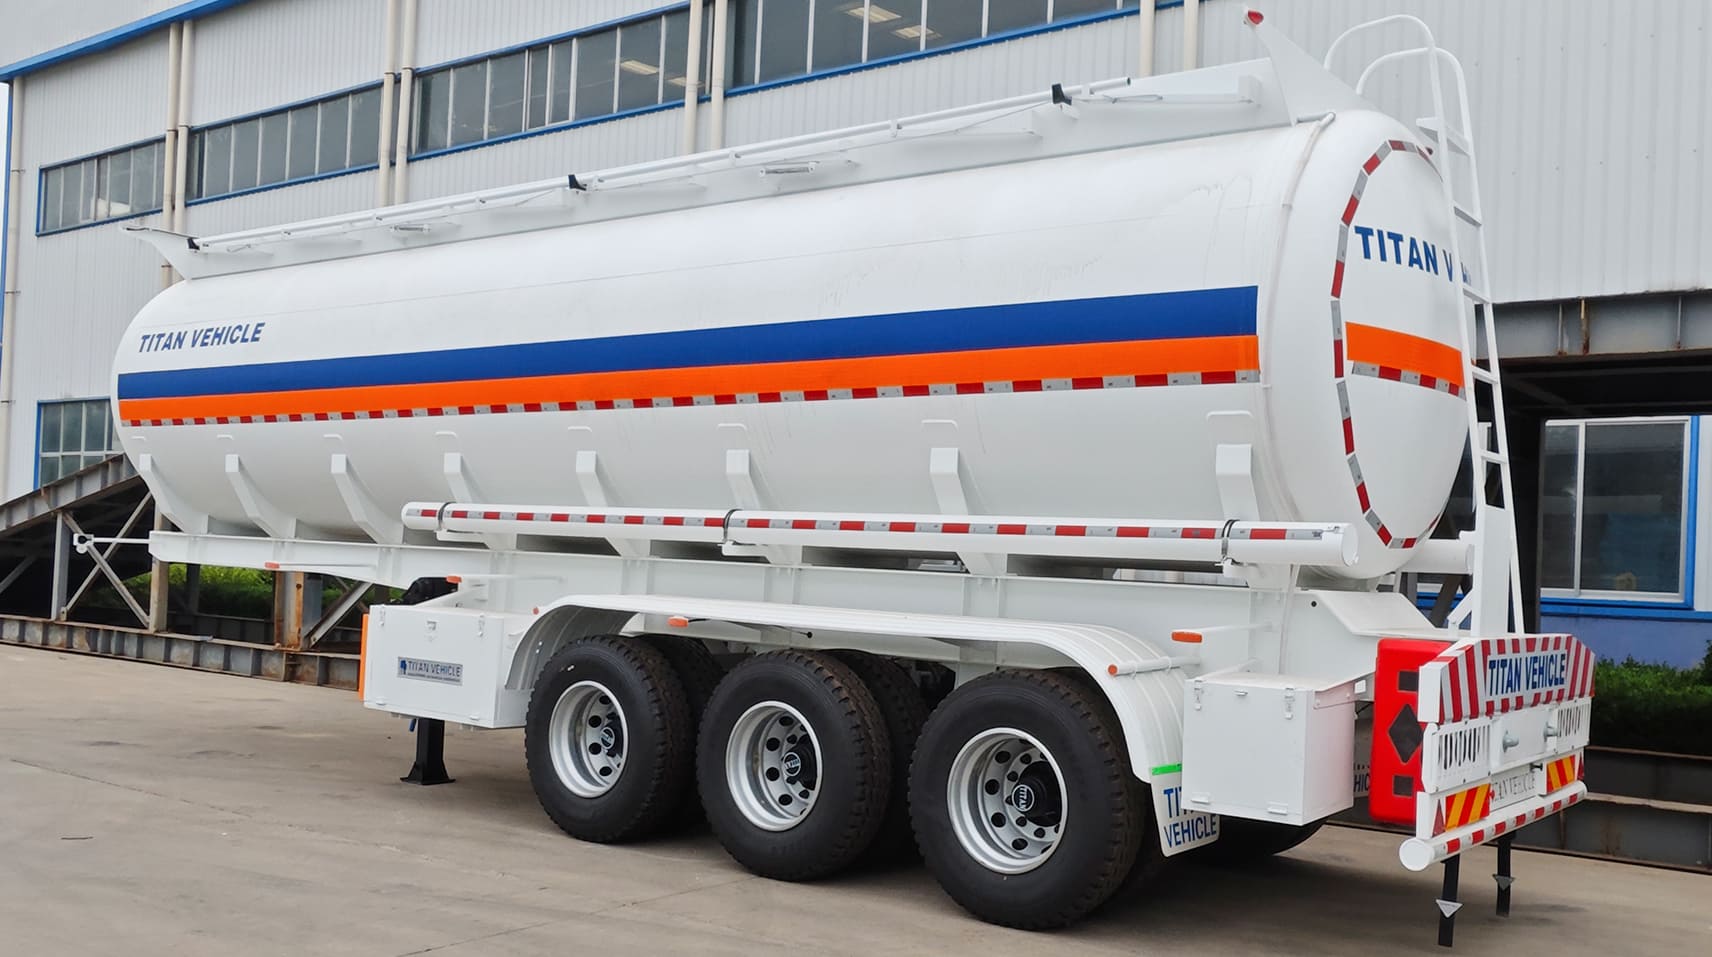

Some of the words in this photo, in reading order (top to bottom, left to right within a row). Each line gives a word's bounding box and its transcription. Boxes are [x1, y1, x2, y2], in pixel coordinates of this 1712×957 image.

[1354, 225, 1439, 276] TITAN
[138, 330, 188, 353] TITAN
[191, 322, 266, 348] VEHICLE
[1489, 657, 1522, 696] TITAN
[1525, 653, 1566, 691] VEHICLE
[1163, 814, 1217, 849] VEHICLE
